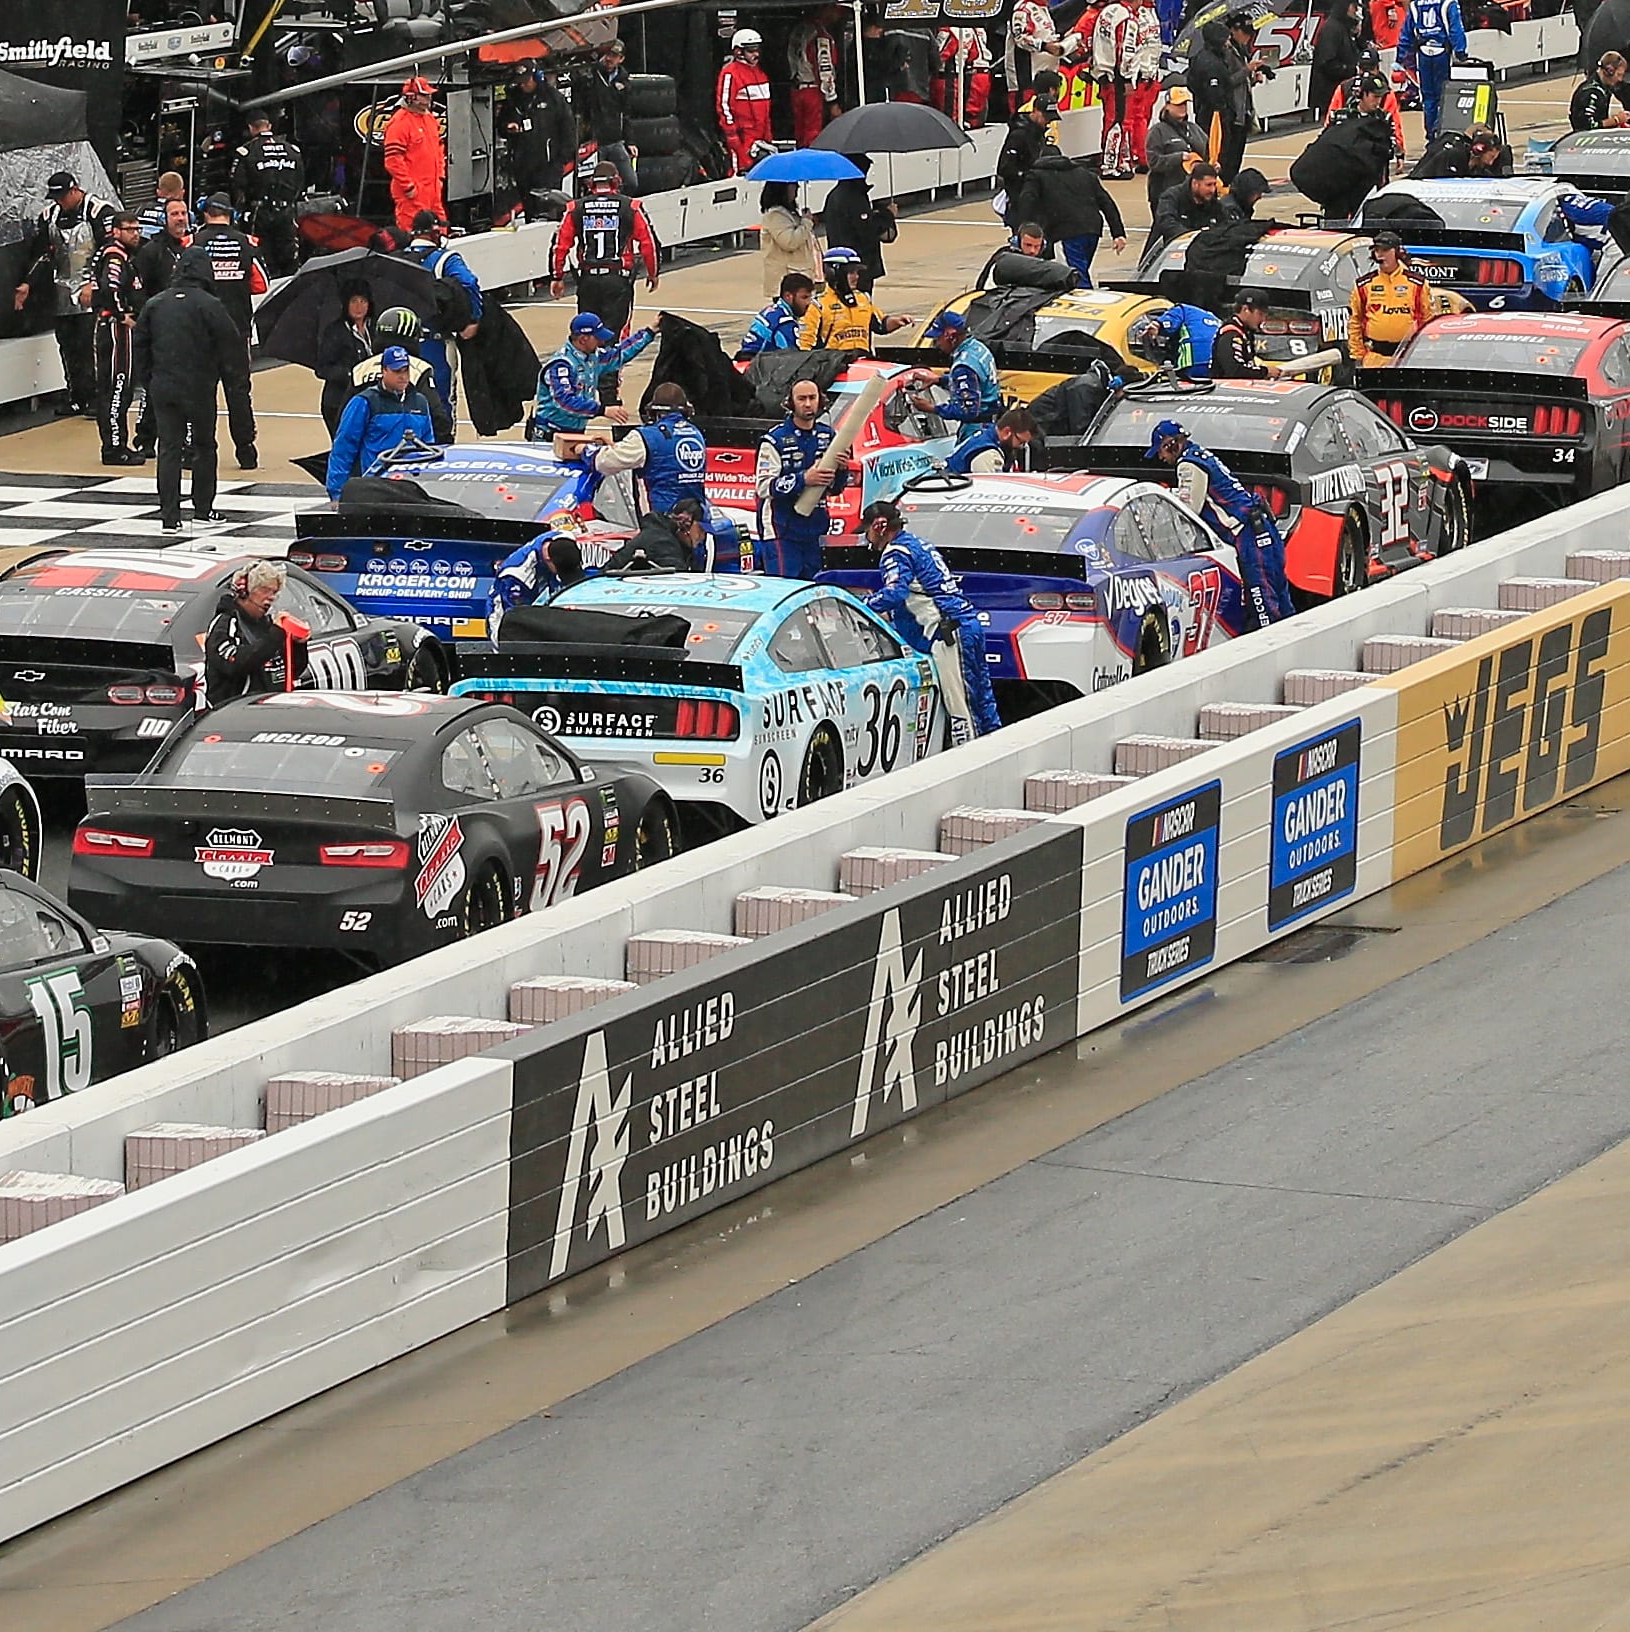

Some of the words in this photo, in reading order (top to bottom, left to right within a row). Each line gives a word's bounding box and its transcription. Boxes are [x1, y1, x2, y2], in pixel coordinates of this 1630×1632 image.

[58, 59, 111, 70] RACING
[1582, 147, 1619, 156] KURT
[593, 231, 605, 259] 1
[1488, 295, 1507, 309] 6
[1289, 338, 1308, 355] 8
[1456, 333, 1546, 344] MCDOWELL
[1175, 405, 1235, 415] LAJOIE
[1552, 448, 1575, 463] 34
[437, 472, 509, 484] PREECE
[971, 492, 1051, 505] Degree
[1374, 461, 1410, 544] 32
[938, 503, 1044, 516] BUESCHER
[358, 574, 477, 589] KROGER.COM
[55, 587, 136, 599] CASSILL
[1114, 576, 1159, 616] Degree
[1042, 610, 1069, 624] 37
[1188, 567, 1222, 657] 37
[761, 679, 846, 730] SURFACE
[37, 718, 79, 735] Fiber
[137, 717, 173, 738] 00
[567, 712, 656, 729] SURFACE
[856, 679, 908, 778] 36
[1439, 607, 1613, 851] JEGS
[251, 730, 347, 747] MCLEOD
[566, 729, 655, 739] SUNSCREEN
[754, 729, 798, 746] SUNSCREEN
[1305, 738, 1339, 779] NASCAR
[699, 767, 725, 784] 36
[1283, 776, 1347, 845] GANDER
[1159, 800, 1196, 843] NASCAR
[212, 831, 258, 847] BELMONT
[200, 848, 270, 866] Classic
[530, 798, 591, 911] 52
[229, 879, 259, 890] .com
[1135, 845, 1205, 914] GANDER
[938, 872, 1012, 946] ALLIED
[339, 911, 373, 932] 52
[936, 951, 999, 1018] STEEL
[26, 967, 93, 1101] 15
[650, 990, 736, 1071] ALLIED
[933, 993, 1046, 1087] BUILDINGS
[647, 1070, 722, 1146] STEEL
[645, 1119, 774, 1222] BUILDINGS
